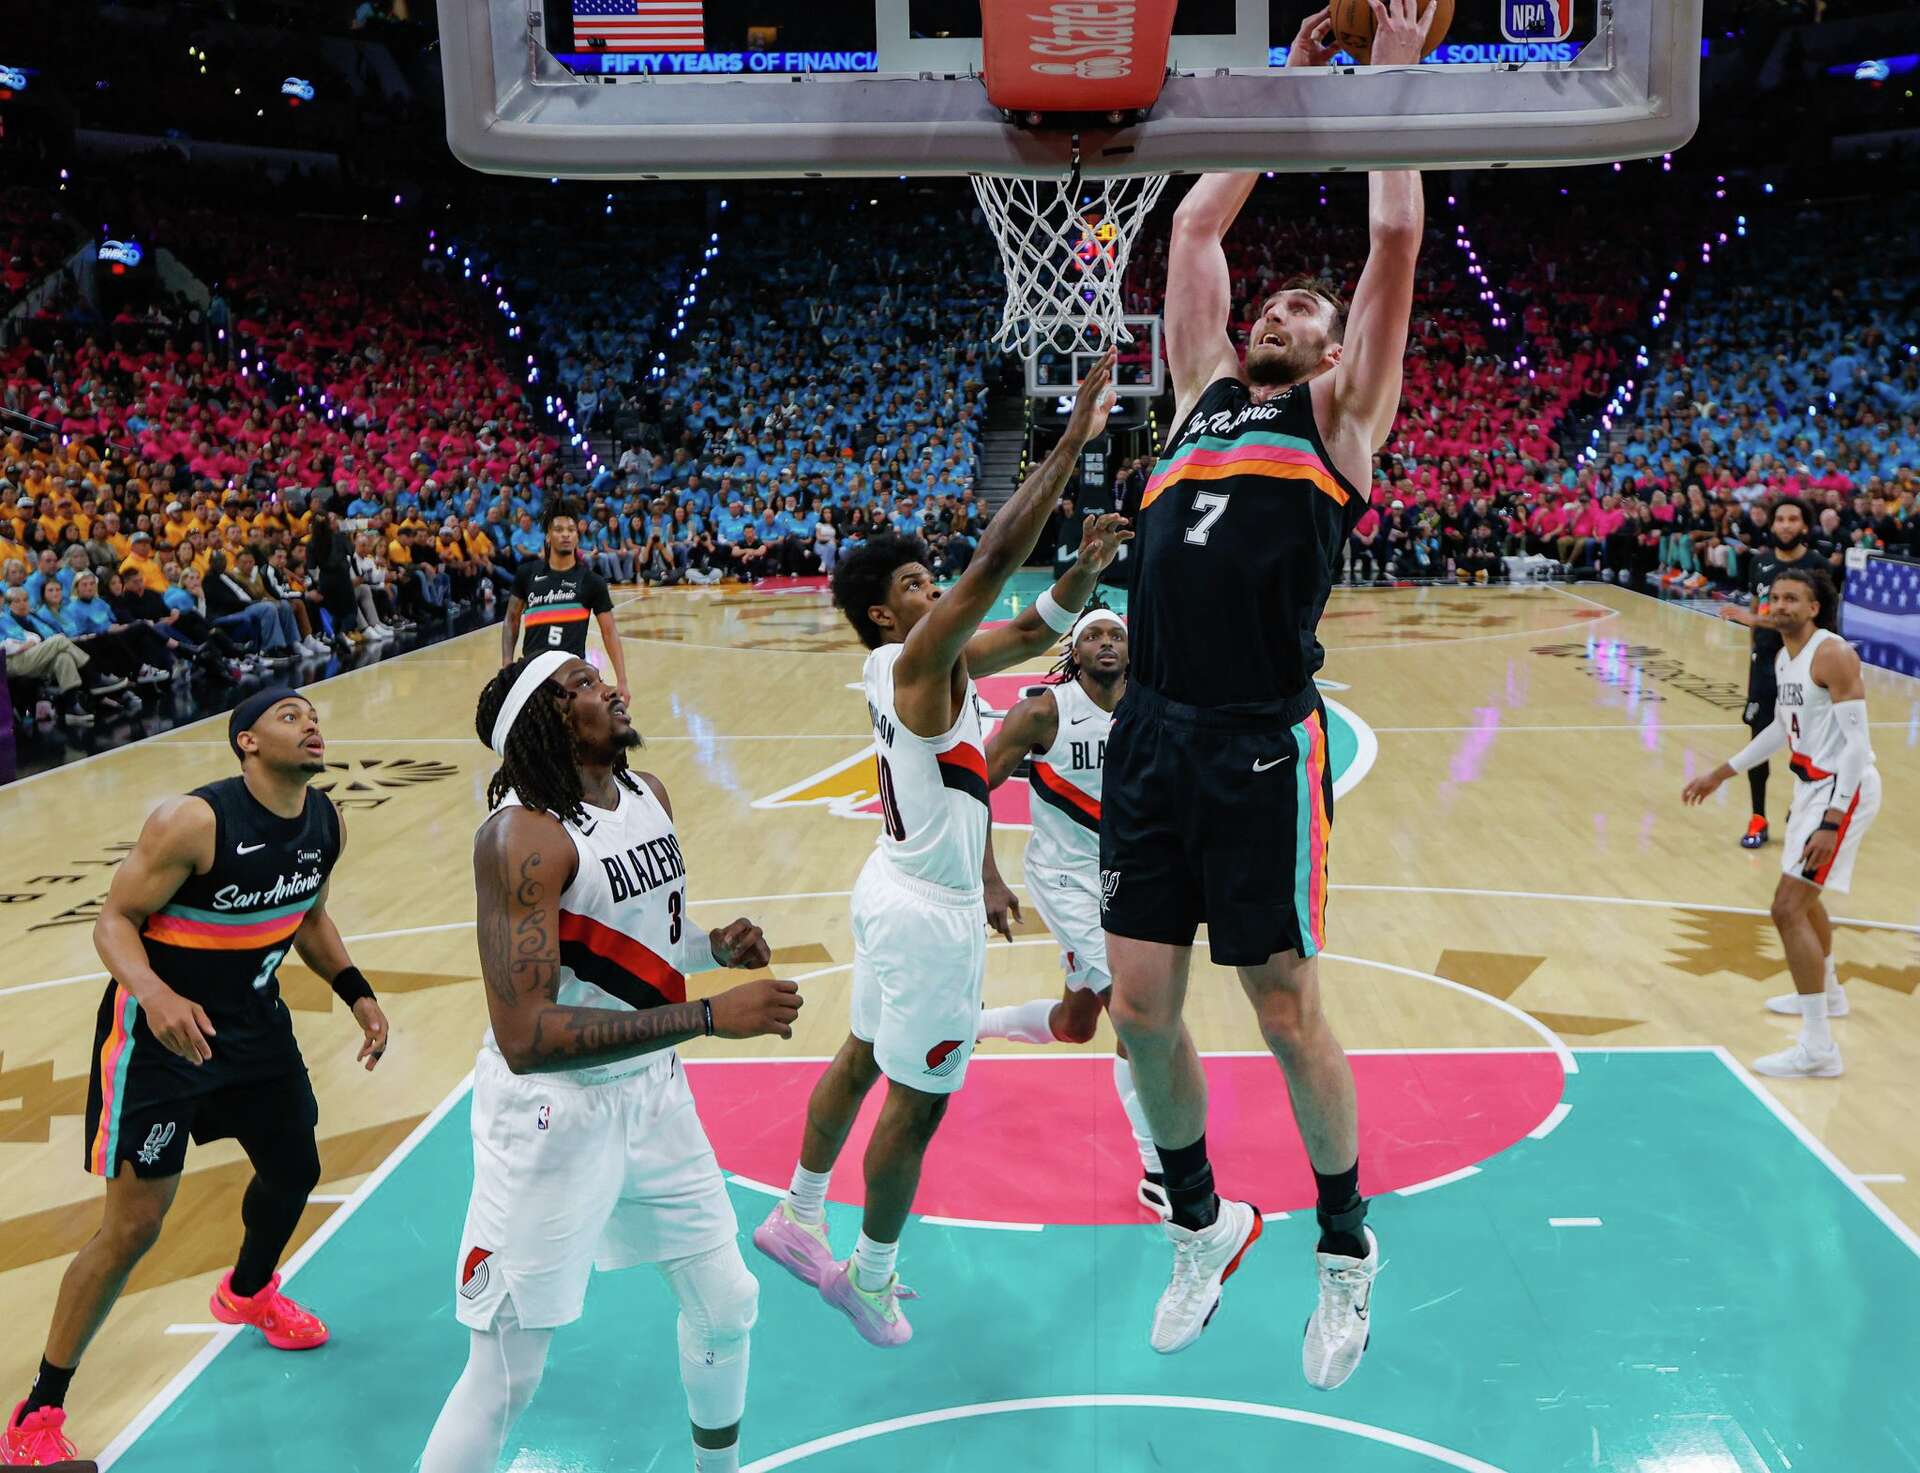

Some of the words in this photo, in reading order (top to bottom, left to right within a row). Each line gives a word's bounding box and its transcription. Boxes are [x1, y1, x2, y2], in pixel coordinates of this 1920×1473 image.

[1026, 4, 1136, 56] State
[1512, 4, 1546, 31] NBA
[601, 53, 662, 73] FIFTY
[668, 53, 743, 72] YEARS
[750, 51, 780, 71] OF
[1449, 43, 1571, 63] SOLUTIONS
[1183, 490, 1230, 546] 7
[528, 591, 543, 607] San
[543, 588, 576, 604] Antonio
[547, 625, 563, 647] 5
[1791, 711, 1800, 739] 4
[600, 833, 686, 904] BLAZERS
[212, 884, 261, 911] San
[263, 867, 322, 905] Antonio
